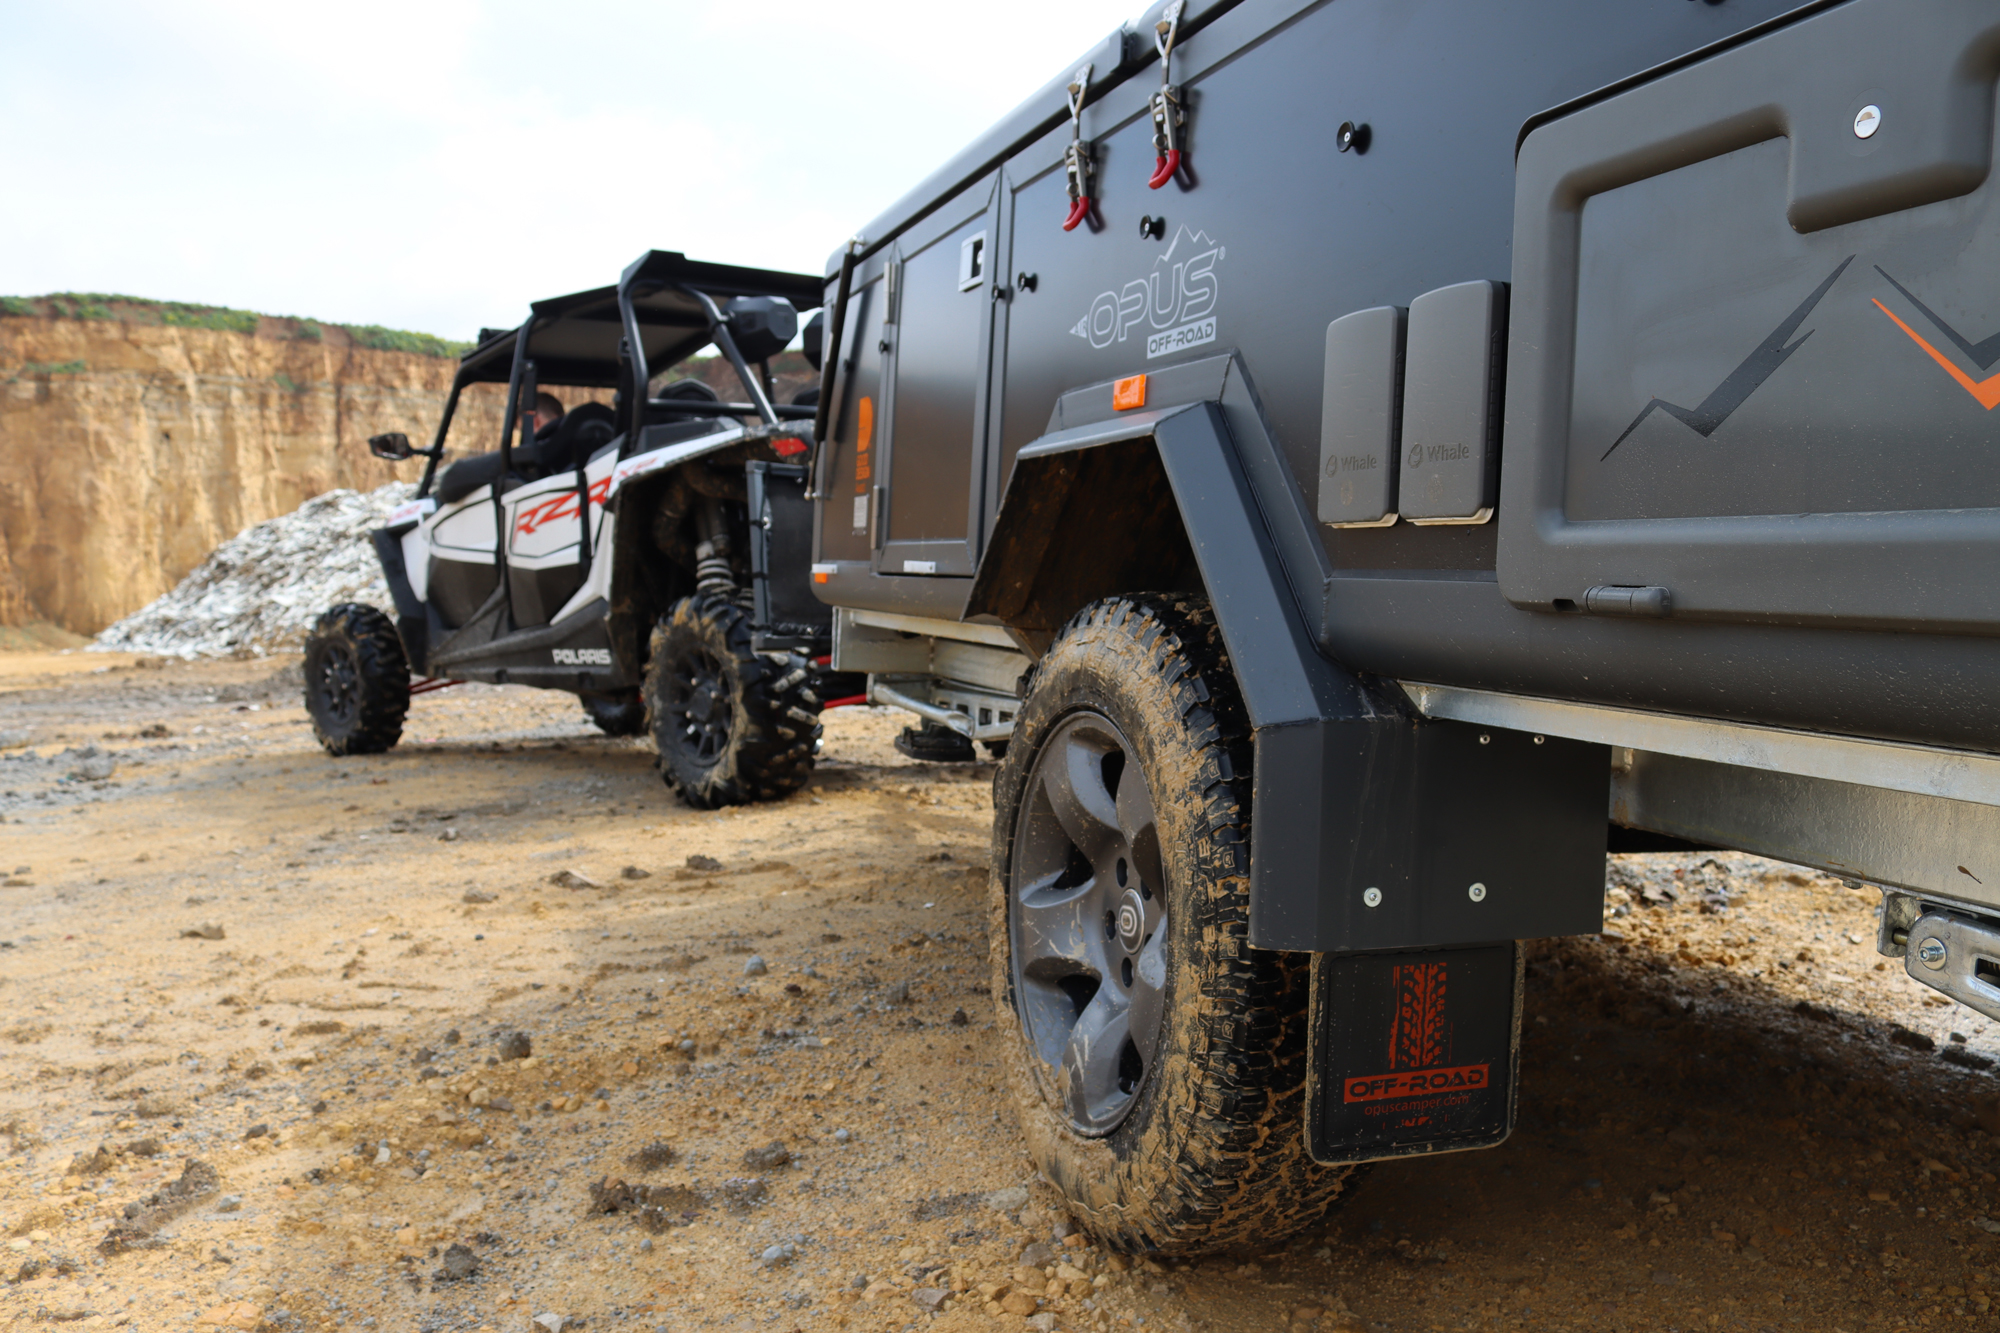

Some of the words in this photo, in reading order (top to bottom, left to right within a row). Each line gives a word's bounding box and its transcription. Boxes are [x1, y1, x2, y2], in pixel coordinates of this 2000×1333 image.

[1089, 249, 1218, 348] OPUS
[1149, 323, 1213, 353] OFF-ROAD
[1341, 454, 1377, 471] Whale
[1428, 443, 1470, 462] Whale
[516, 476, 612, 535] RZR
[551, 648, 612, 665] POLARIS
[1350, 1070, 1484, 1098] OFF-ROAD
[1364, 1096, 1469, 1117] opuscamper.com
